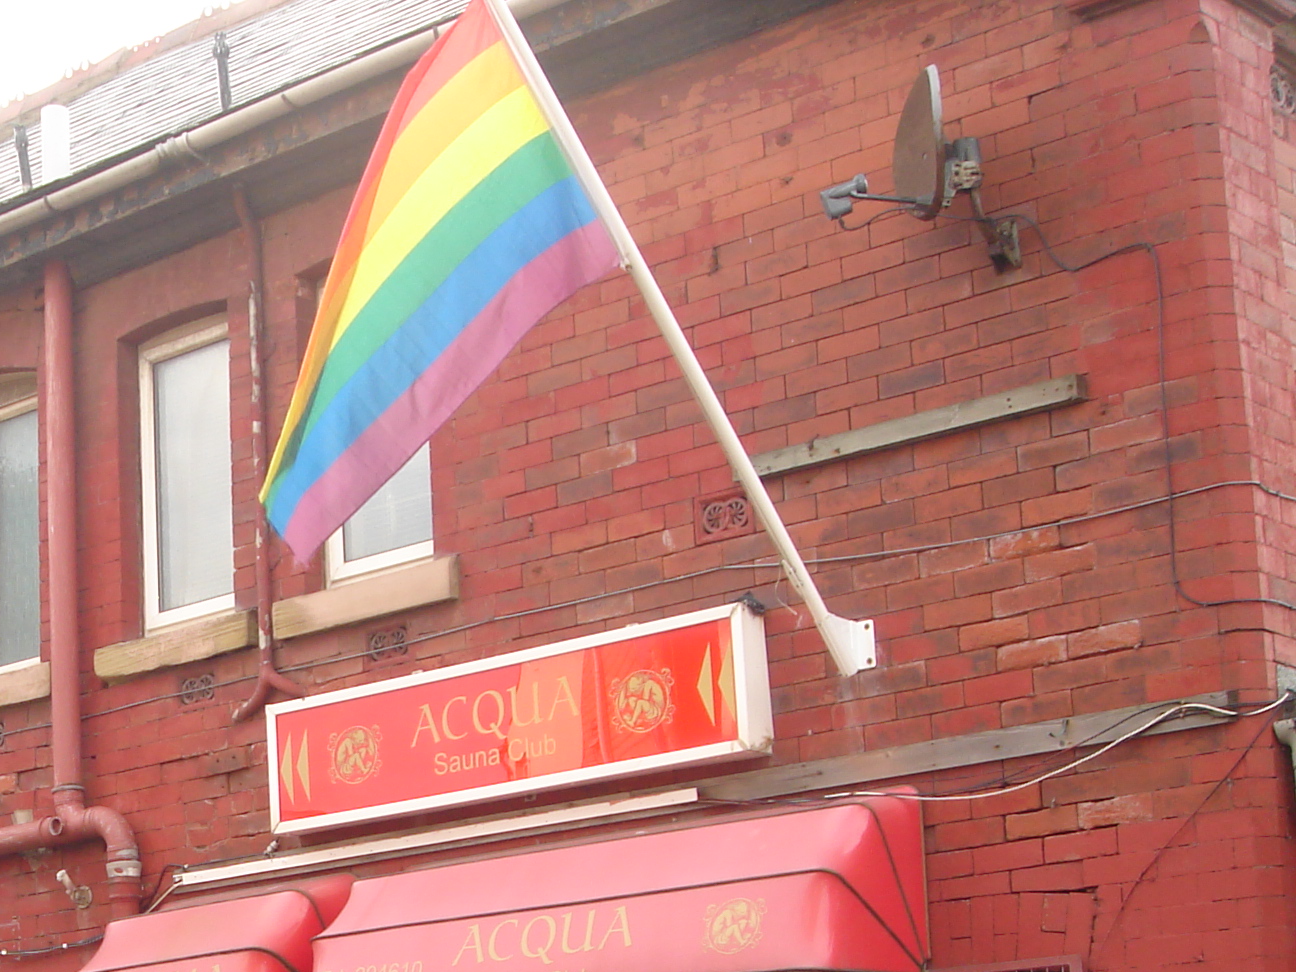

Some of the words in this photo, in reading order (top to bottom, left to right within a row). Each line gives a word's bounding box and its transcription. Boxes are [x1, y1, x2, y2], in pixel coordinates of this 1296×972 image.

[410, 676, 580, 748] ACQUA
[434, 747, 501, 776] Sauna
[508, 736, 557, 762] Club
[451, 905, 632, 966] ACQUA
